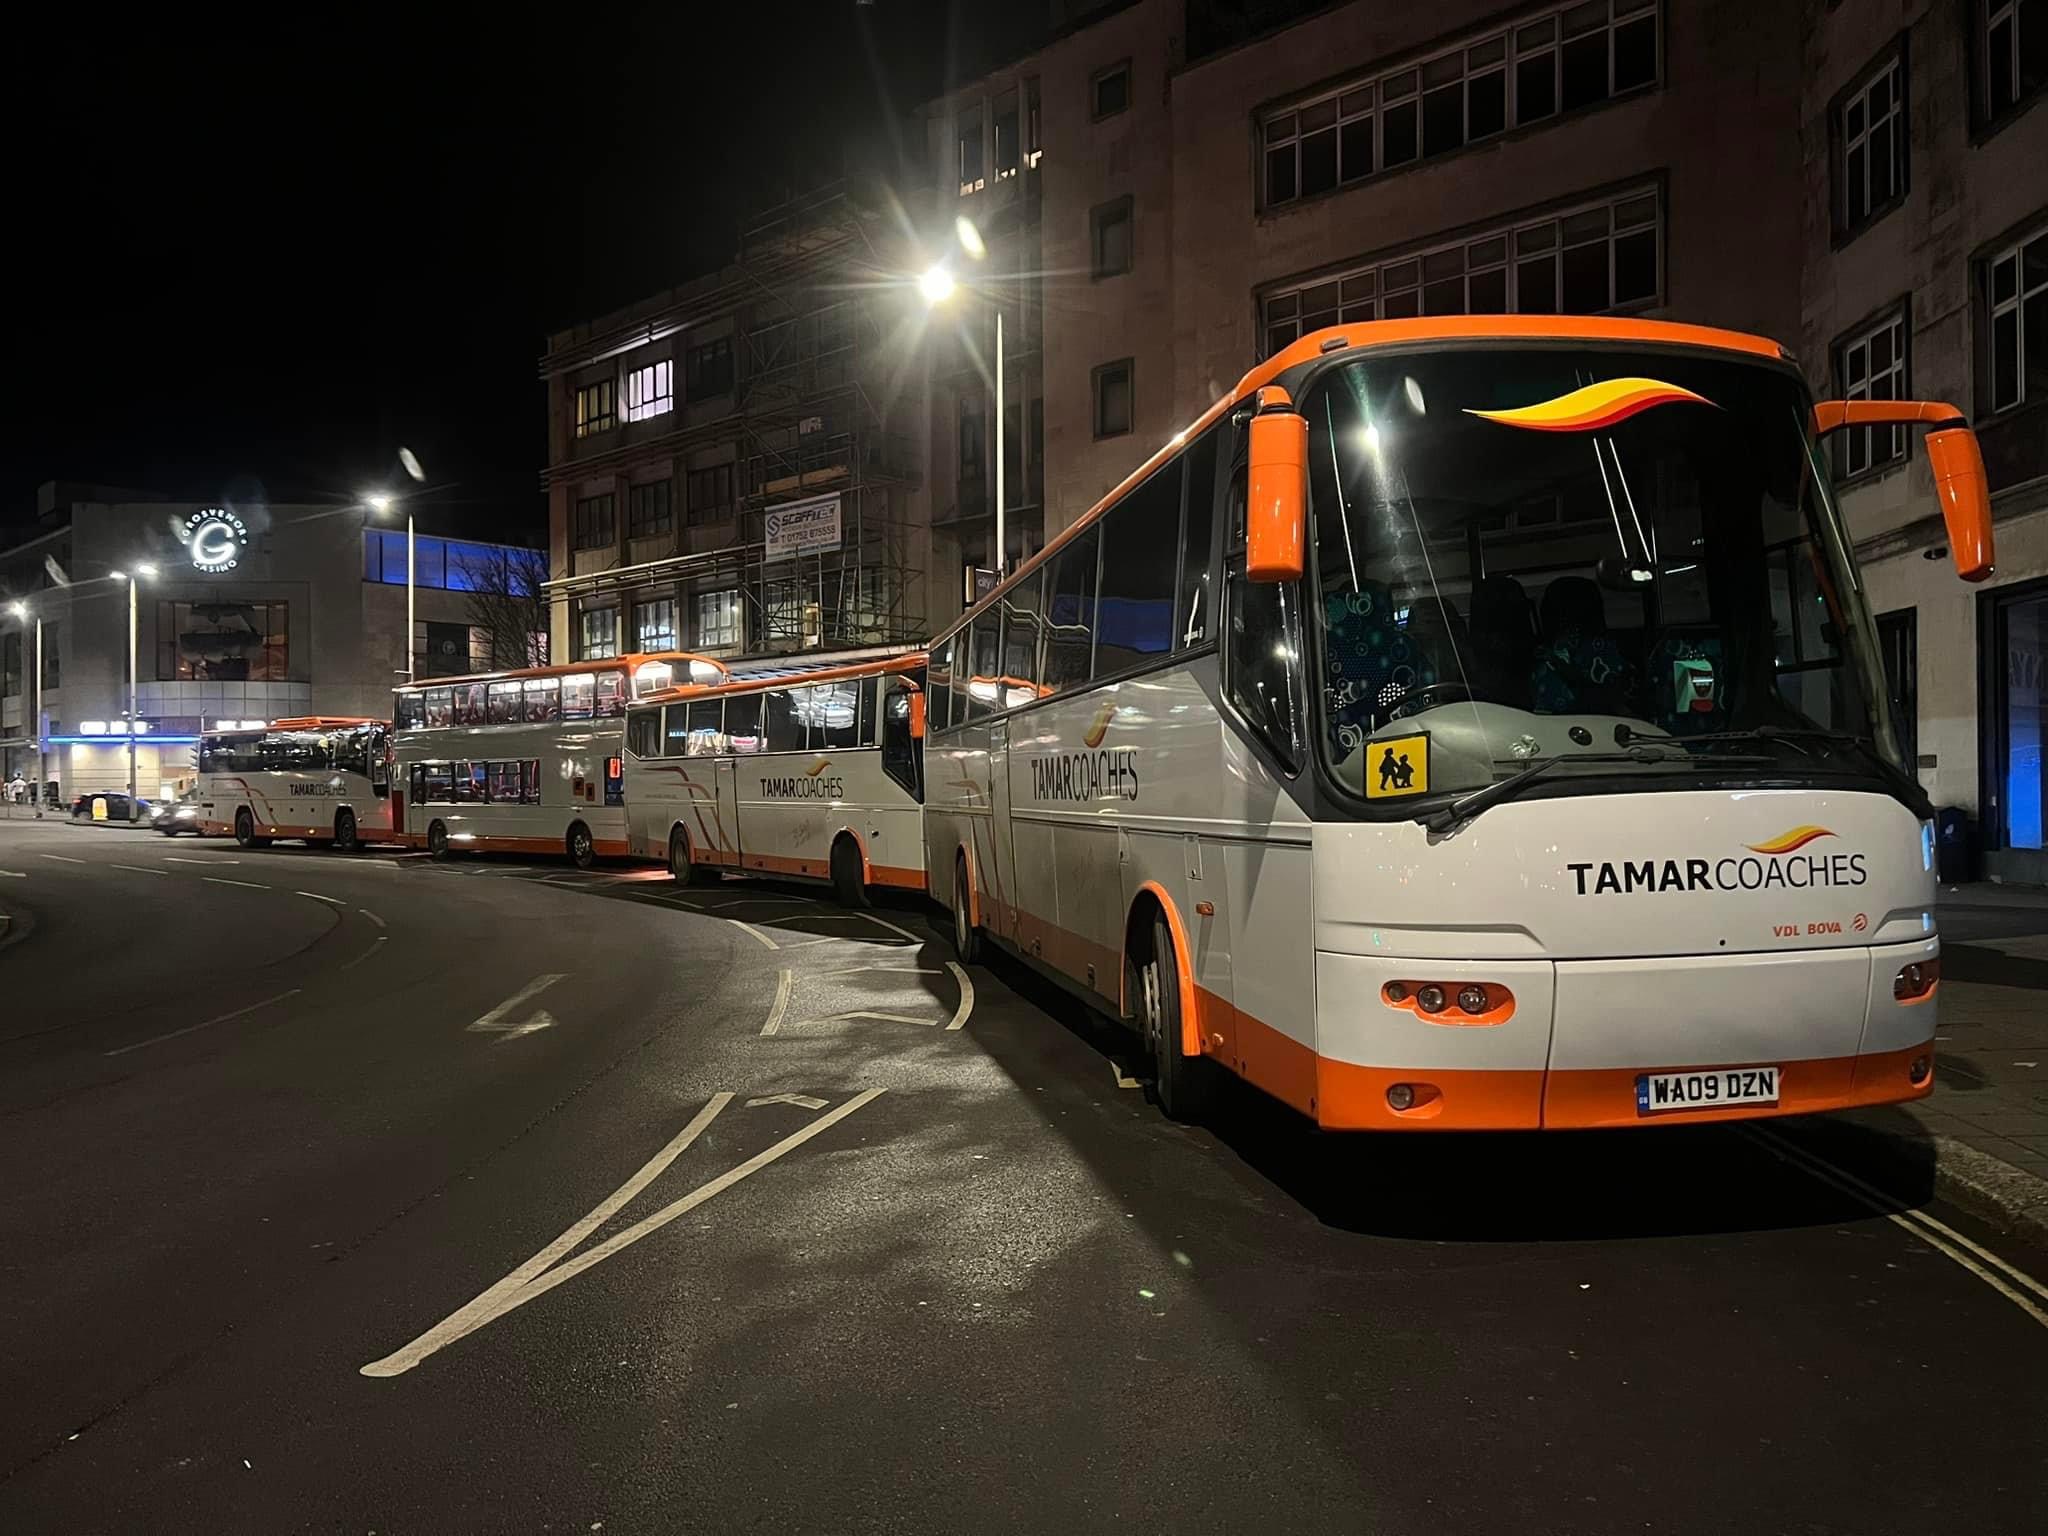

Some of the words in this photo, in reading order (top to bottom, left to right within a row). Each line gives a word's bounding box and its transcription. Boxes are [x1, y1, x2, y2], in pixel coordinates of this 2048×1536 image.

[182, 509, 247, 537] GROSVENOR
[193, 517, 236, 565] G
[193, 560, 237, 573] CASINO
[760, 777, 844, 799] TAMARCOACHES
[1567, 854, 1867, 895] TAMARCOACHES
[1773, 925, 1801, 937] VDL
[1807, 922, 1842, 935] BOVA
[1653, 1075, 1719, 1104] WA09
[1726, 1071, 1774, 1098] DZN
